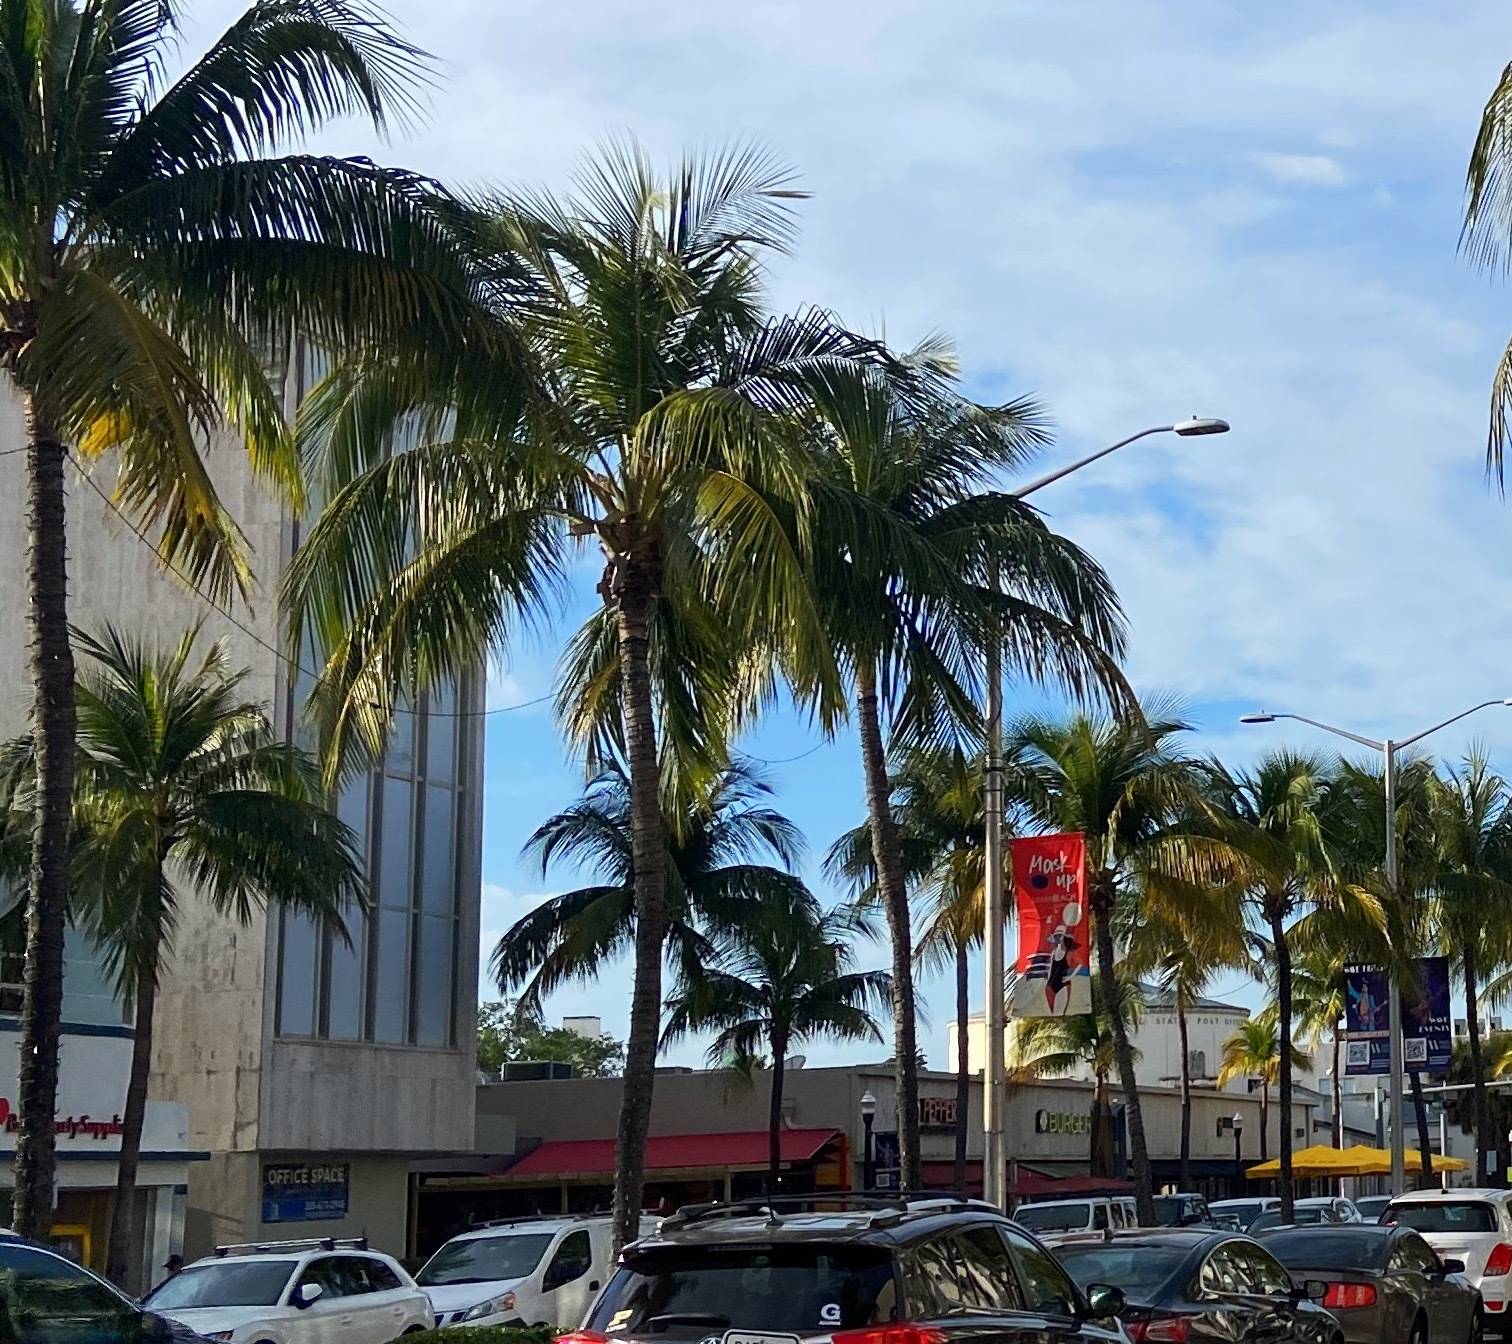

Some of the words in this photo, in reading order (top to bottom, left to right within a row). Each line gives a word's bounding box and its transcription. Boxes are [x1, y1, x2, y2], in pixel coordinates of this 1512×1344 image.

[1028, 850, 1073, 875] Mask
[1155, 1017, 1188, 1025] STATS
[1050, 1112, 1092, 1134] BURGER
[268, 1169, 309, 1184] OFFICE
[311, 1167, 345, 1183] SPACE
[820, 1303, 841, 1321] G
